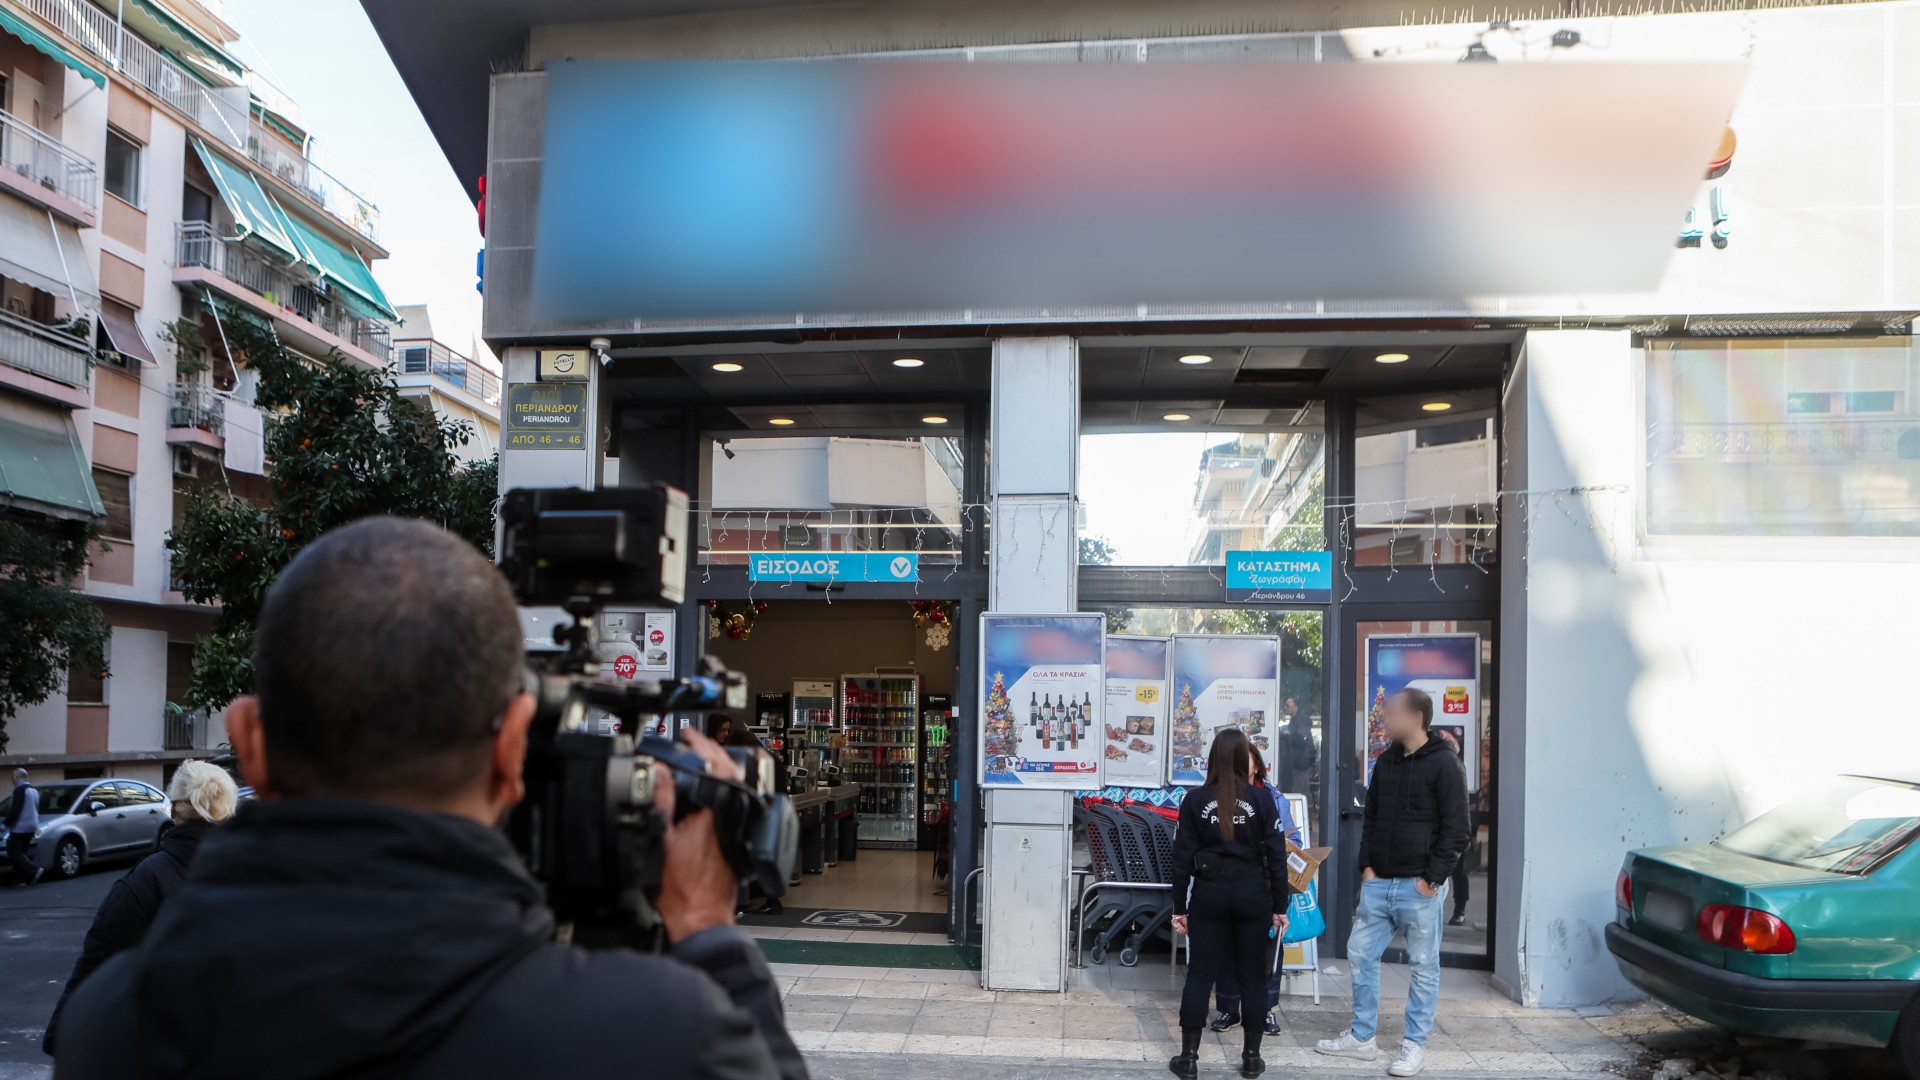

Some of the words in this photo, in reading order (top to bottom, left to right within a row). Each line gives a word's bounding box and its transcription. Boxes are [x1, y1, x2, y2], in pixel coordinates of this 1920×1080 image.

[515, 404, 578, 412] ΠΕΡΙΑΝΔΡΟΥ
[512, 435, 535, 444] ΑΠΟ
[540, 436, 551, 444] 46
[568, 436, 580, 444] 46
[758, 560, 840, 574] ΕΙΣΟΔΟΣ
[1237, 561, 1320, 572] ΚΑΤΑΣΤΗΜΑ
[1251, 574, 1306, 585] Ζωγράφου
[1252, 592, 1294, 600] Περιάνδρου
[1210, 816, 1246, 824] PCE
